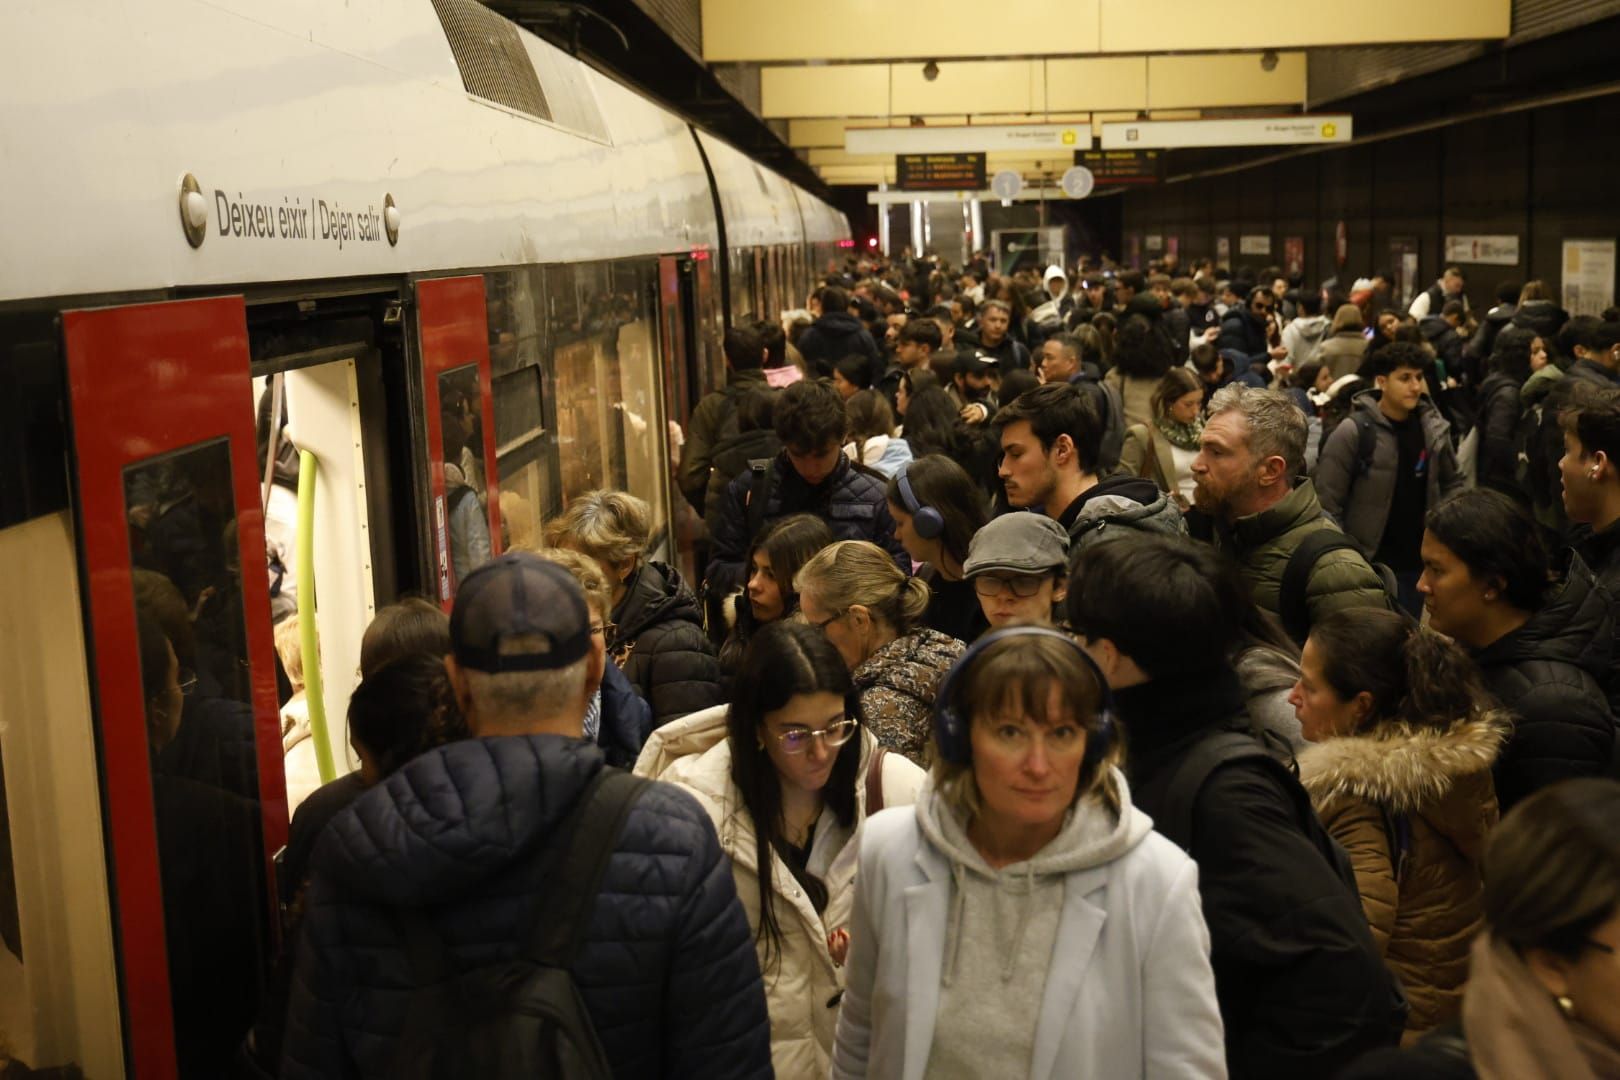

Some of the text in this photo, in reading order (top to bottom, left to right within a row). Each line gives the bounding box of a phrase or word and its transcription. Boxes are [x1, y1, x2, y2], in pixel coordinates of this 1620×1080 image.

[215, 189, 381, 251] Deixeu eixir / Dejen salir
